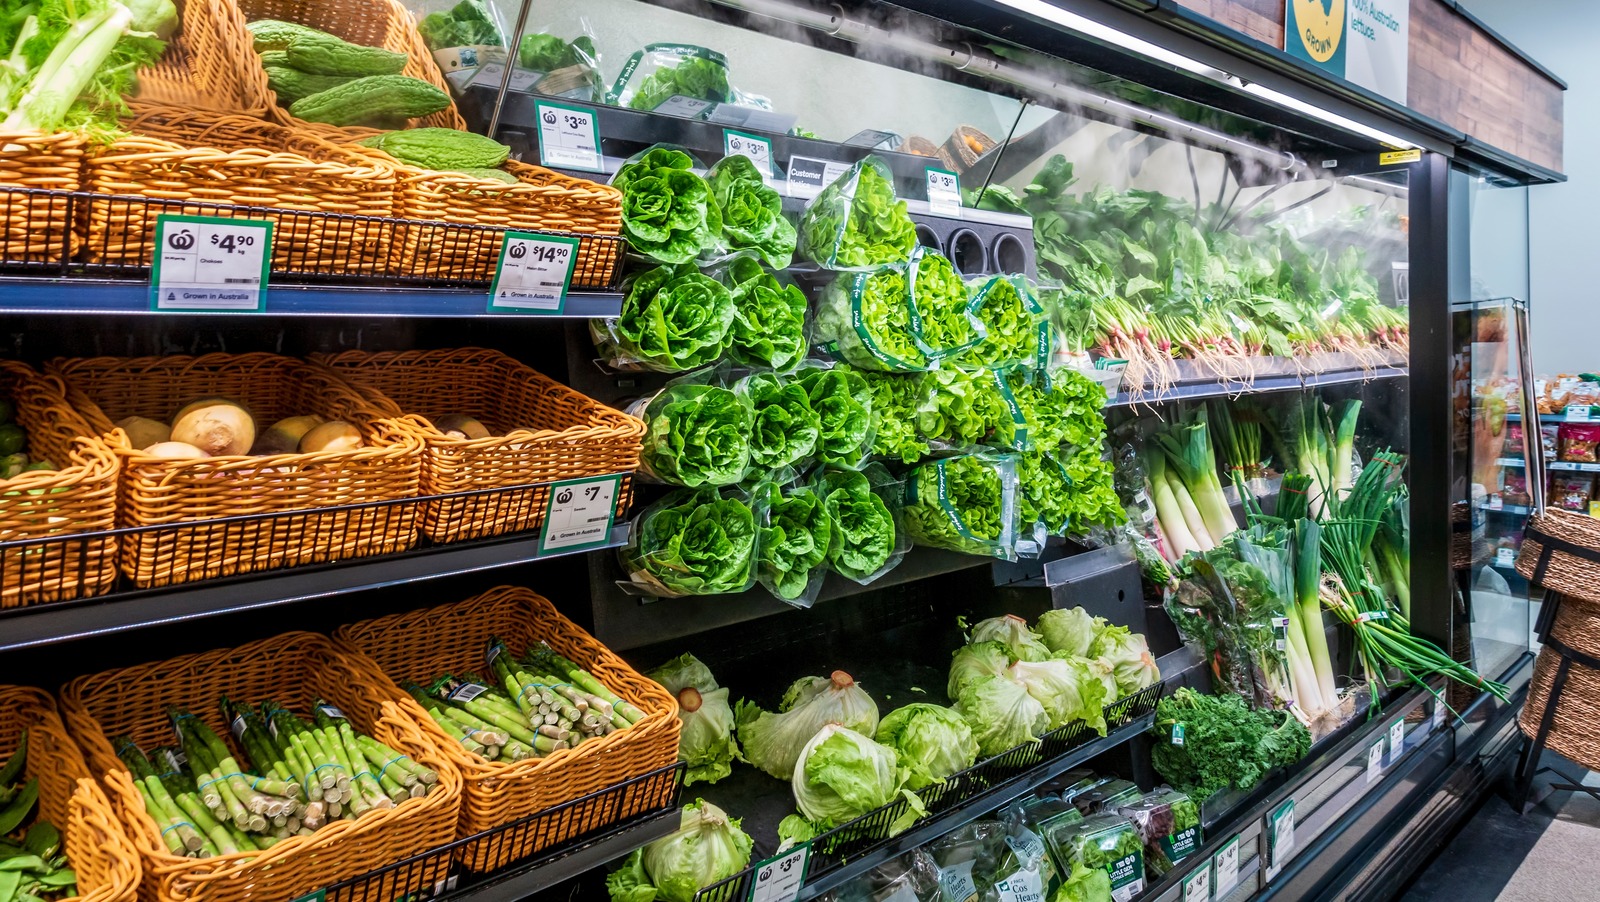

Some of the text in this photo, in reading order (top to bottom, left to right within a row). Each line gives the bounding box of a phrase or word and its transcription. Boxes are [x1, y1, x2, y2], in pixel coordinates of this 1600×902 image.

[1369, 2, 1399, 34] Australian
[1351, 12, 1375, 42] lettuce.
[1306, 28, 1332, 54] GROWN
[791, 168, 822, 180] Customer
[182, 291, 249, 301] Grown in Australia
[510, 291, 528, 299] Grown
[533, 293, 555, 301] Australia
[937, 464, 945, 500] sandwiches
[584, 486, 600, 501] $7
[948, 510, 964, 531] burgers
[1172, 837, 1193, 850] LITTLE GEM
[947, 873, 957, 885] Cos
[1109, 868, 1124, 879] LITTLE
[950, 876, 967, 894] Hearts
[1012, 884, 1028, 893] Cos
[1015, 892, 1040, 902] Hearts
